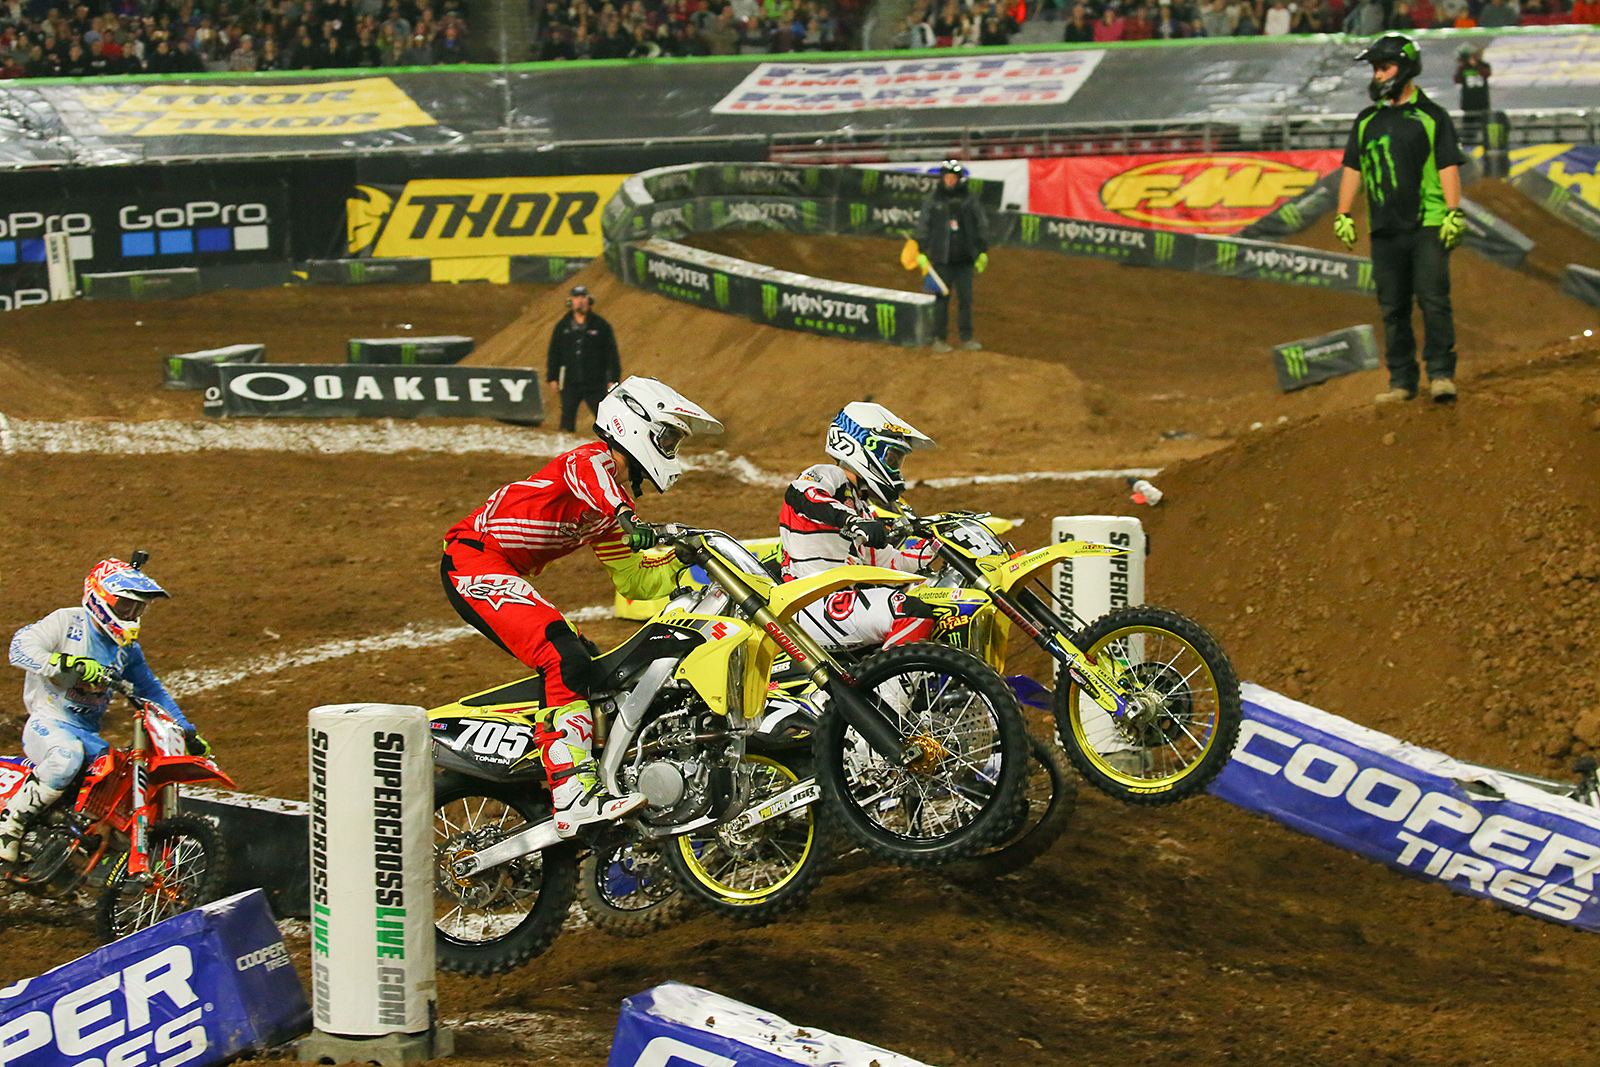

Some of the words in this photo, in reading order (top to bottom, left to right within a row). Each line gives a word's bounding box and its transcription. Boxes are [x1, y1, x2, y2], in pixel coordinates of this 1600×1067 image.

[1104, 166, 1320, 209] FMF
[120, 201, 267, 230] GoPro
[407, 191, 600, 239] THOR
[1048, 220, 1147, 248] MONSTER
[648, 259, 710, 290] MONSTER
[1245, 248, 1349, 279] MONSTER
[782, 291, 870, 324] MONSTER
[794, 316, 856, 333] ENERGY
[313, 375, 530, 402] OAKLEY
[613, 418, 624, 434] BELL
[764, 621, 807, 663] SHOWA
[451, 718, 532, 759] 705
[789, 787, 817, 805] JGR
[1232, 718, 1600, 891] COOPER
[312, 728, 331, 1025] SUPERCROSSLIVE.COM
[373, 731, 407, 1026] SUPERCROSSLIVE.COM
[1396, 830, 1591, 922] TIRES
[236, 941, 288, 972] COOPER
